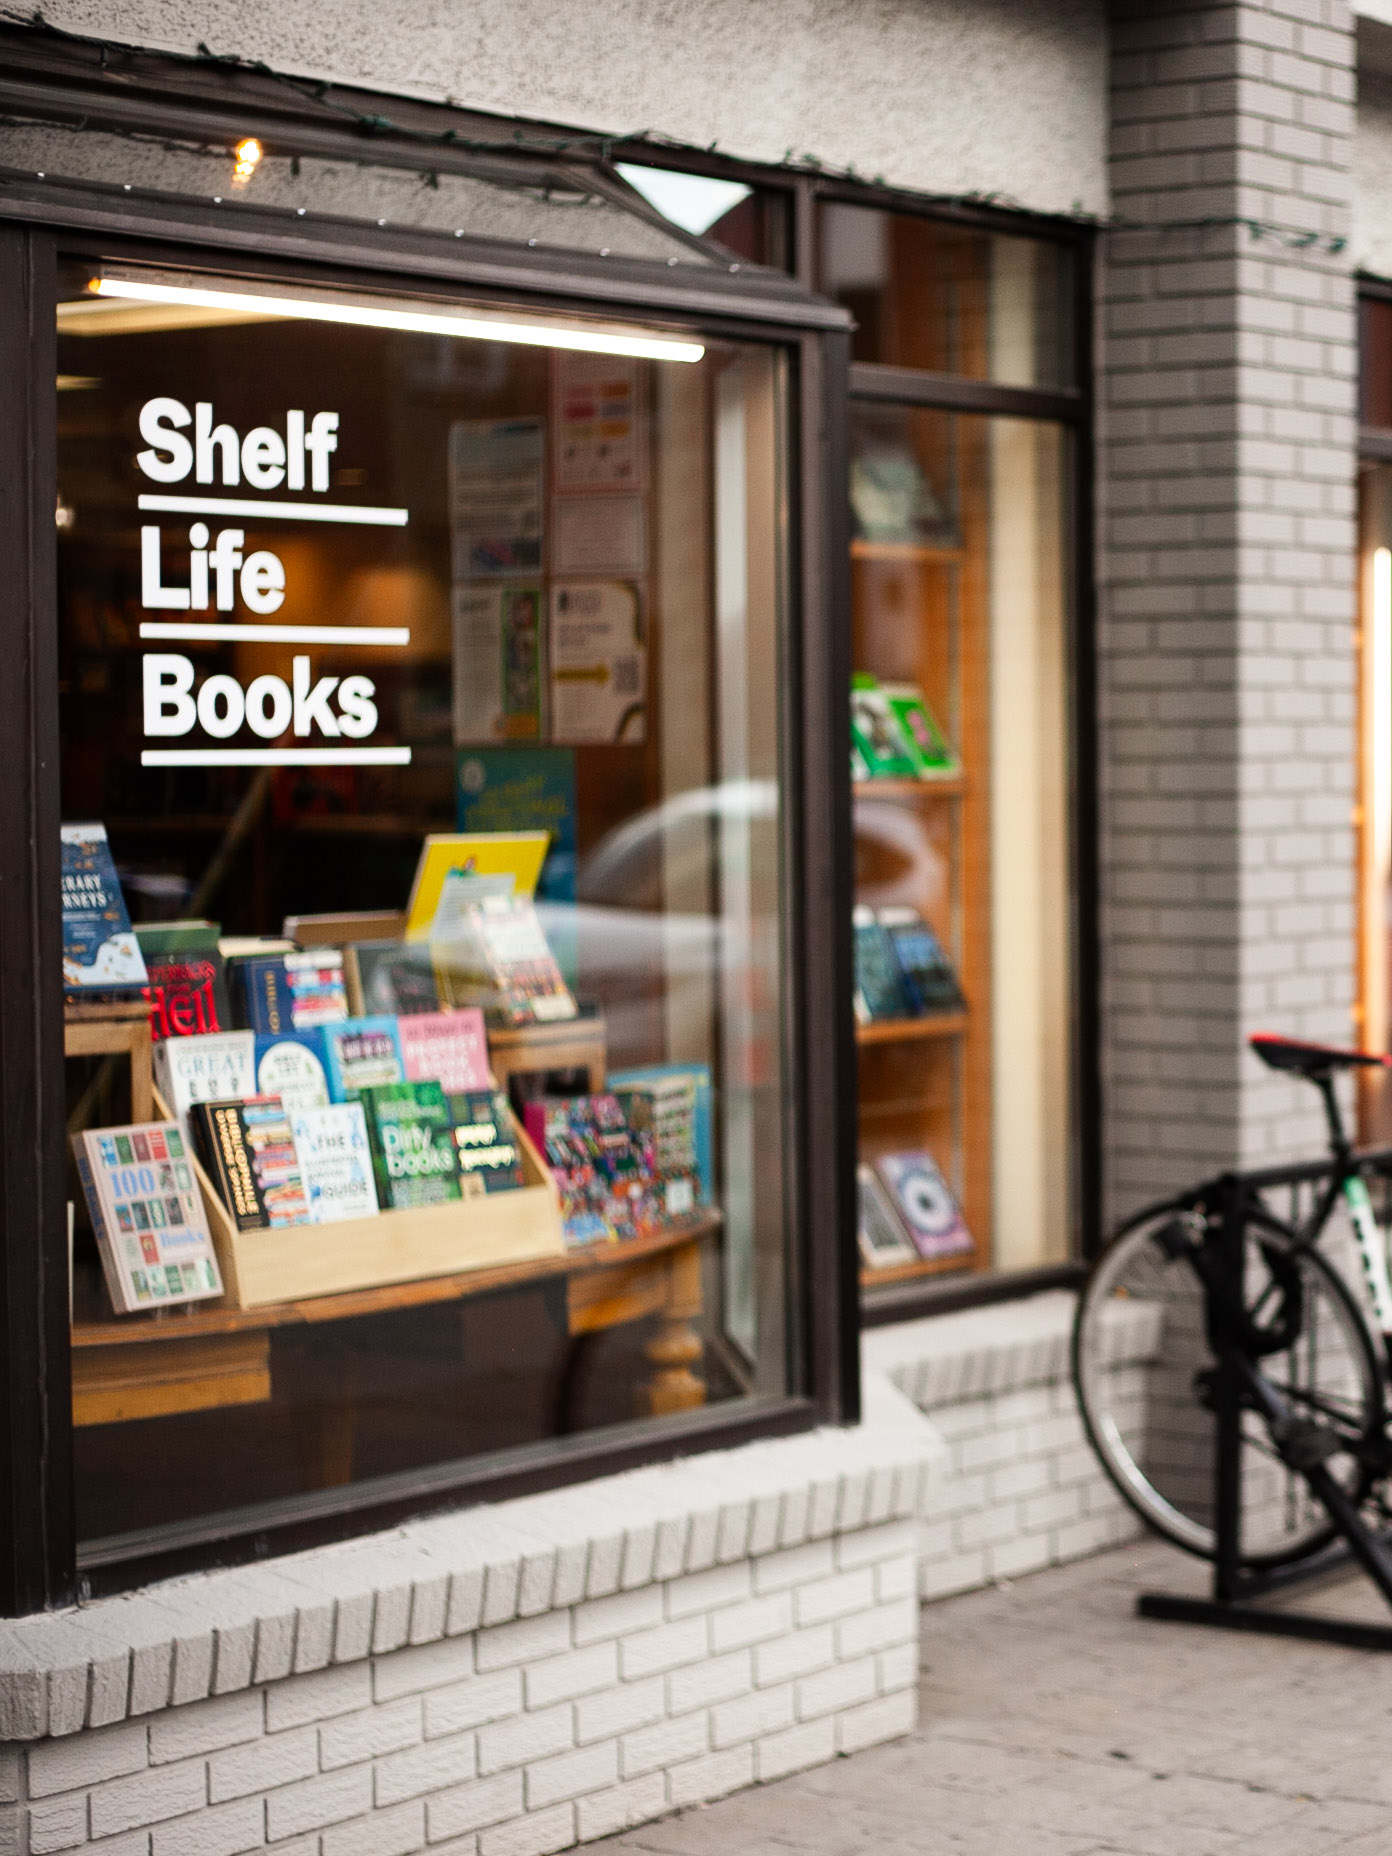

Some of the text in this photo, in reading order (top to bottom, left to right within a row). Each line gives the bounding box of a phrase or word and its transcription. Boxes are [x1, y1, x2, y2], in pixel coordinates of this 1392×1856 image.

[136, 396, 340, 493] Shelf
[140, 521, 286, 615] Life
[142, 653, 379, 739] Books
[140, 980, 222, 1042] Hell
[176, 1052, 246, 1078] GREAT
[109, 1167, 156, 1199] 100
